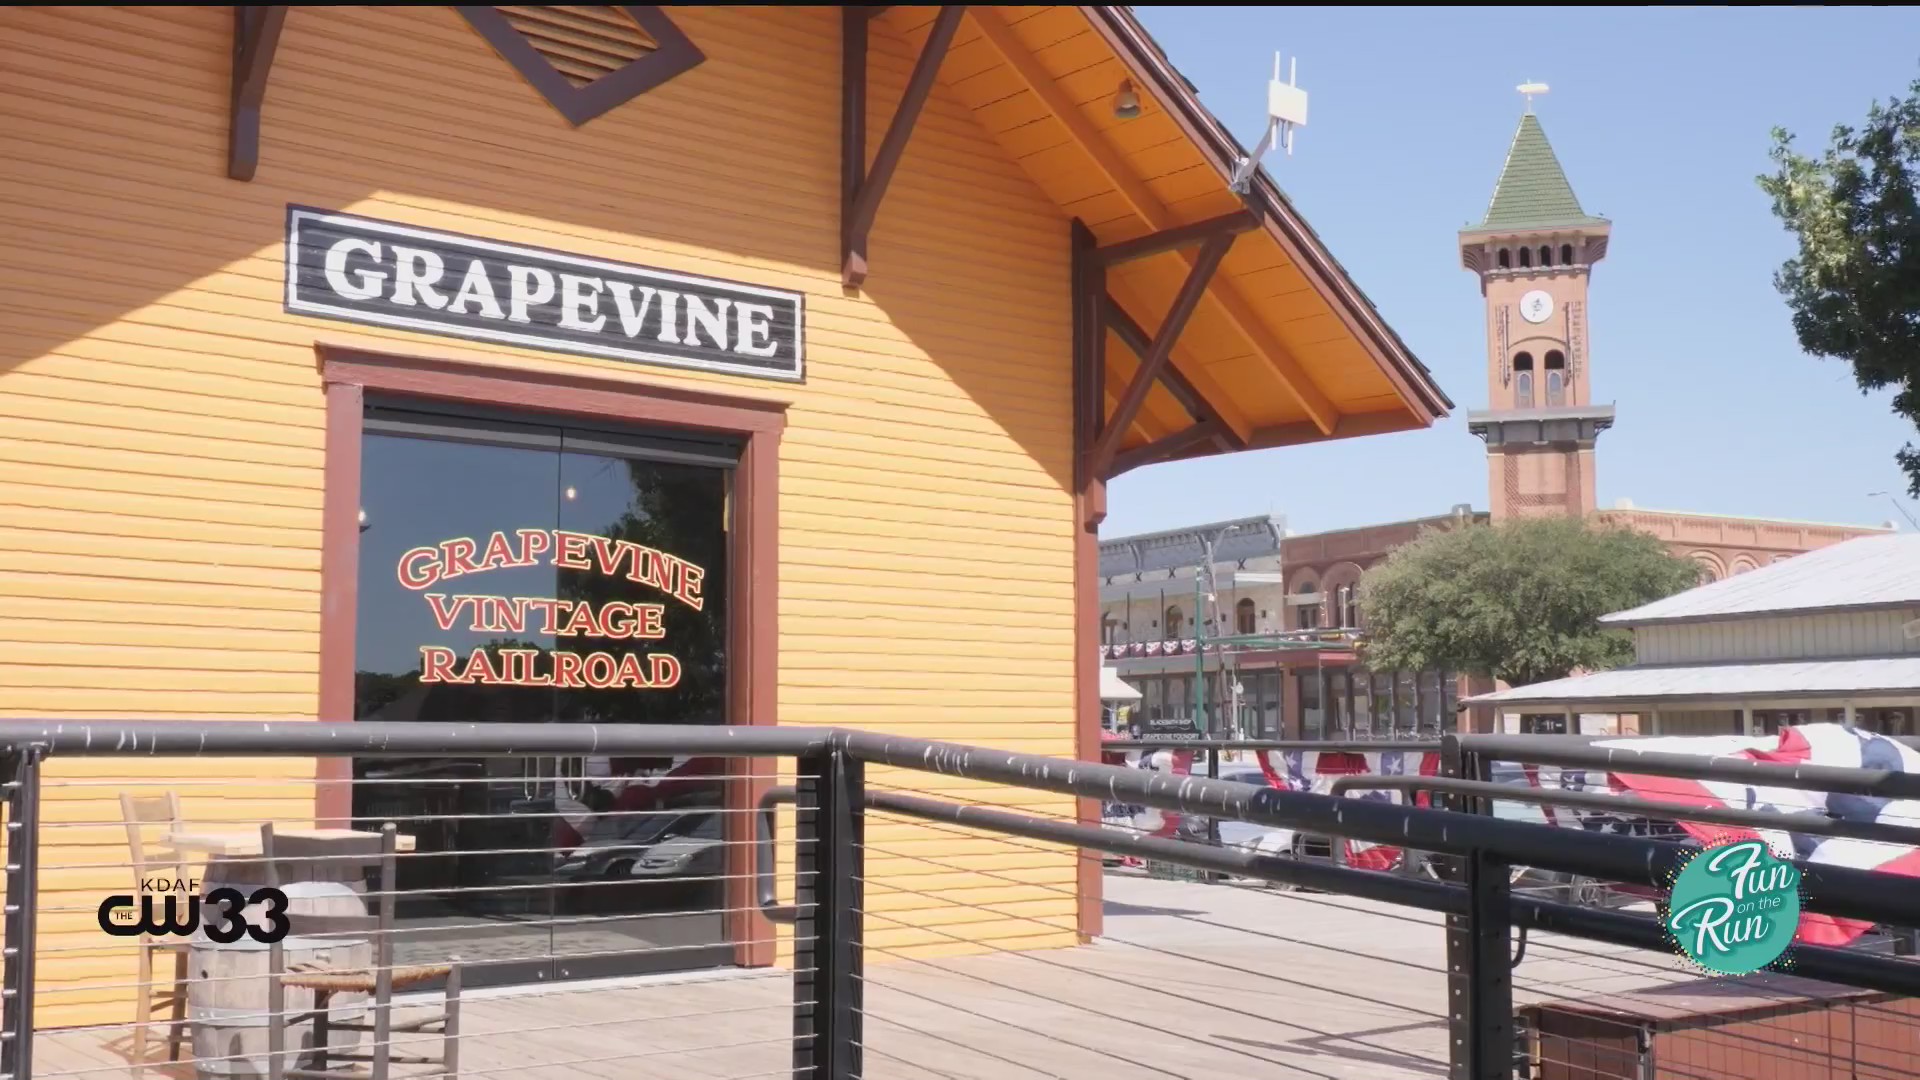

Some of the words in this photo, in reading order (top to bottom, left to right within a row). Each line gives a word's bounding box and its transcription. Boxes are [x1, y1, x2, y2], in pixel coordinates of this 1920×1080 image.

[324, 237, 778, 358] GRAPEVINE
[397, 528, 705, 611] GRAPEVINE
[424, 593, 666, 639] VINTAGE
[419, 645, 681, 689] RAILROAD
